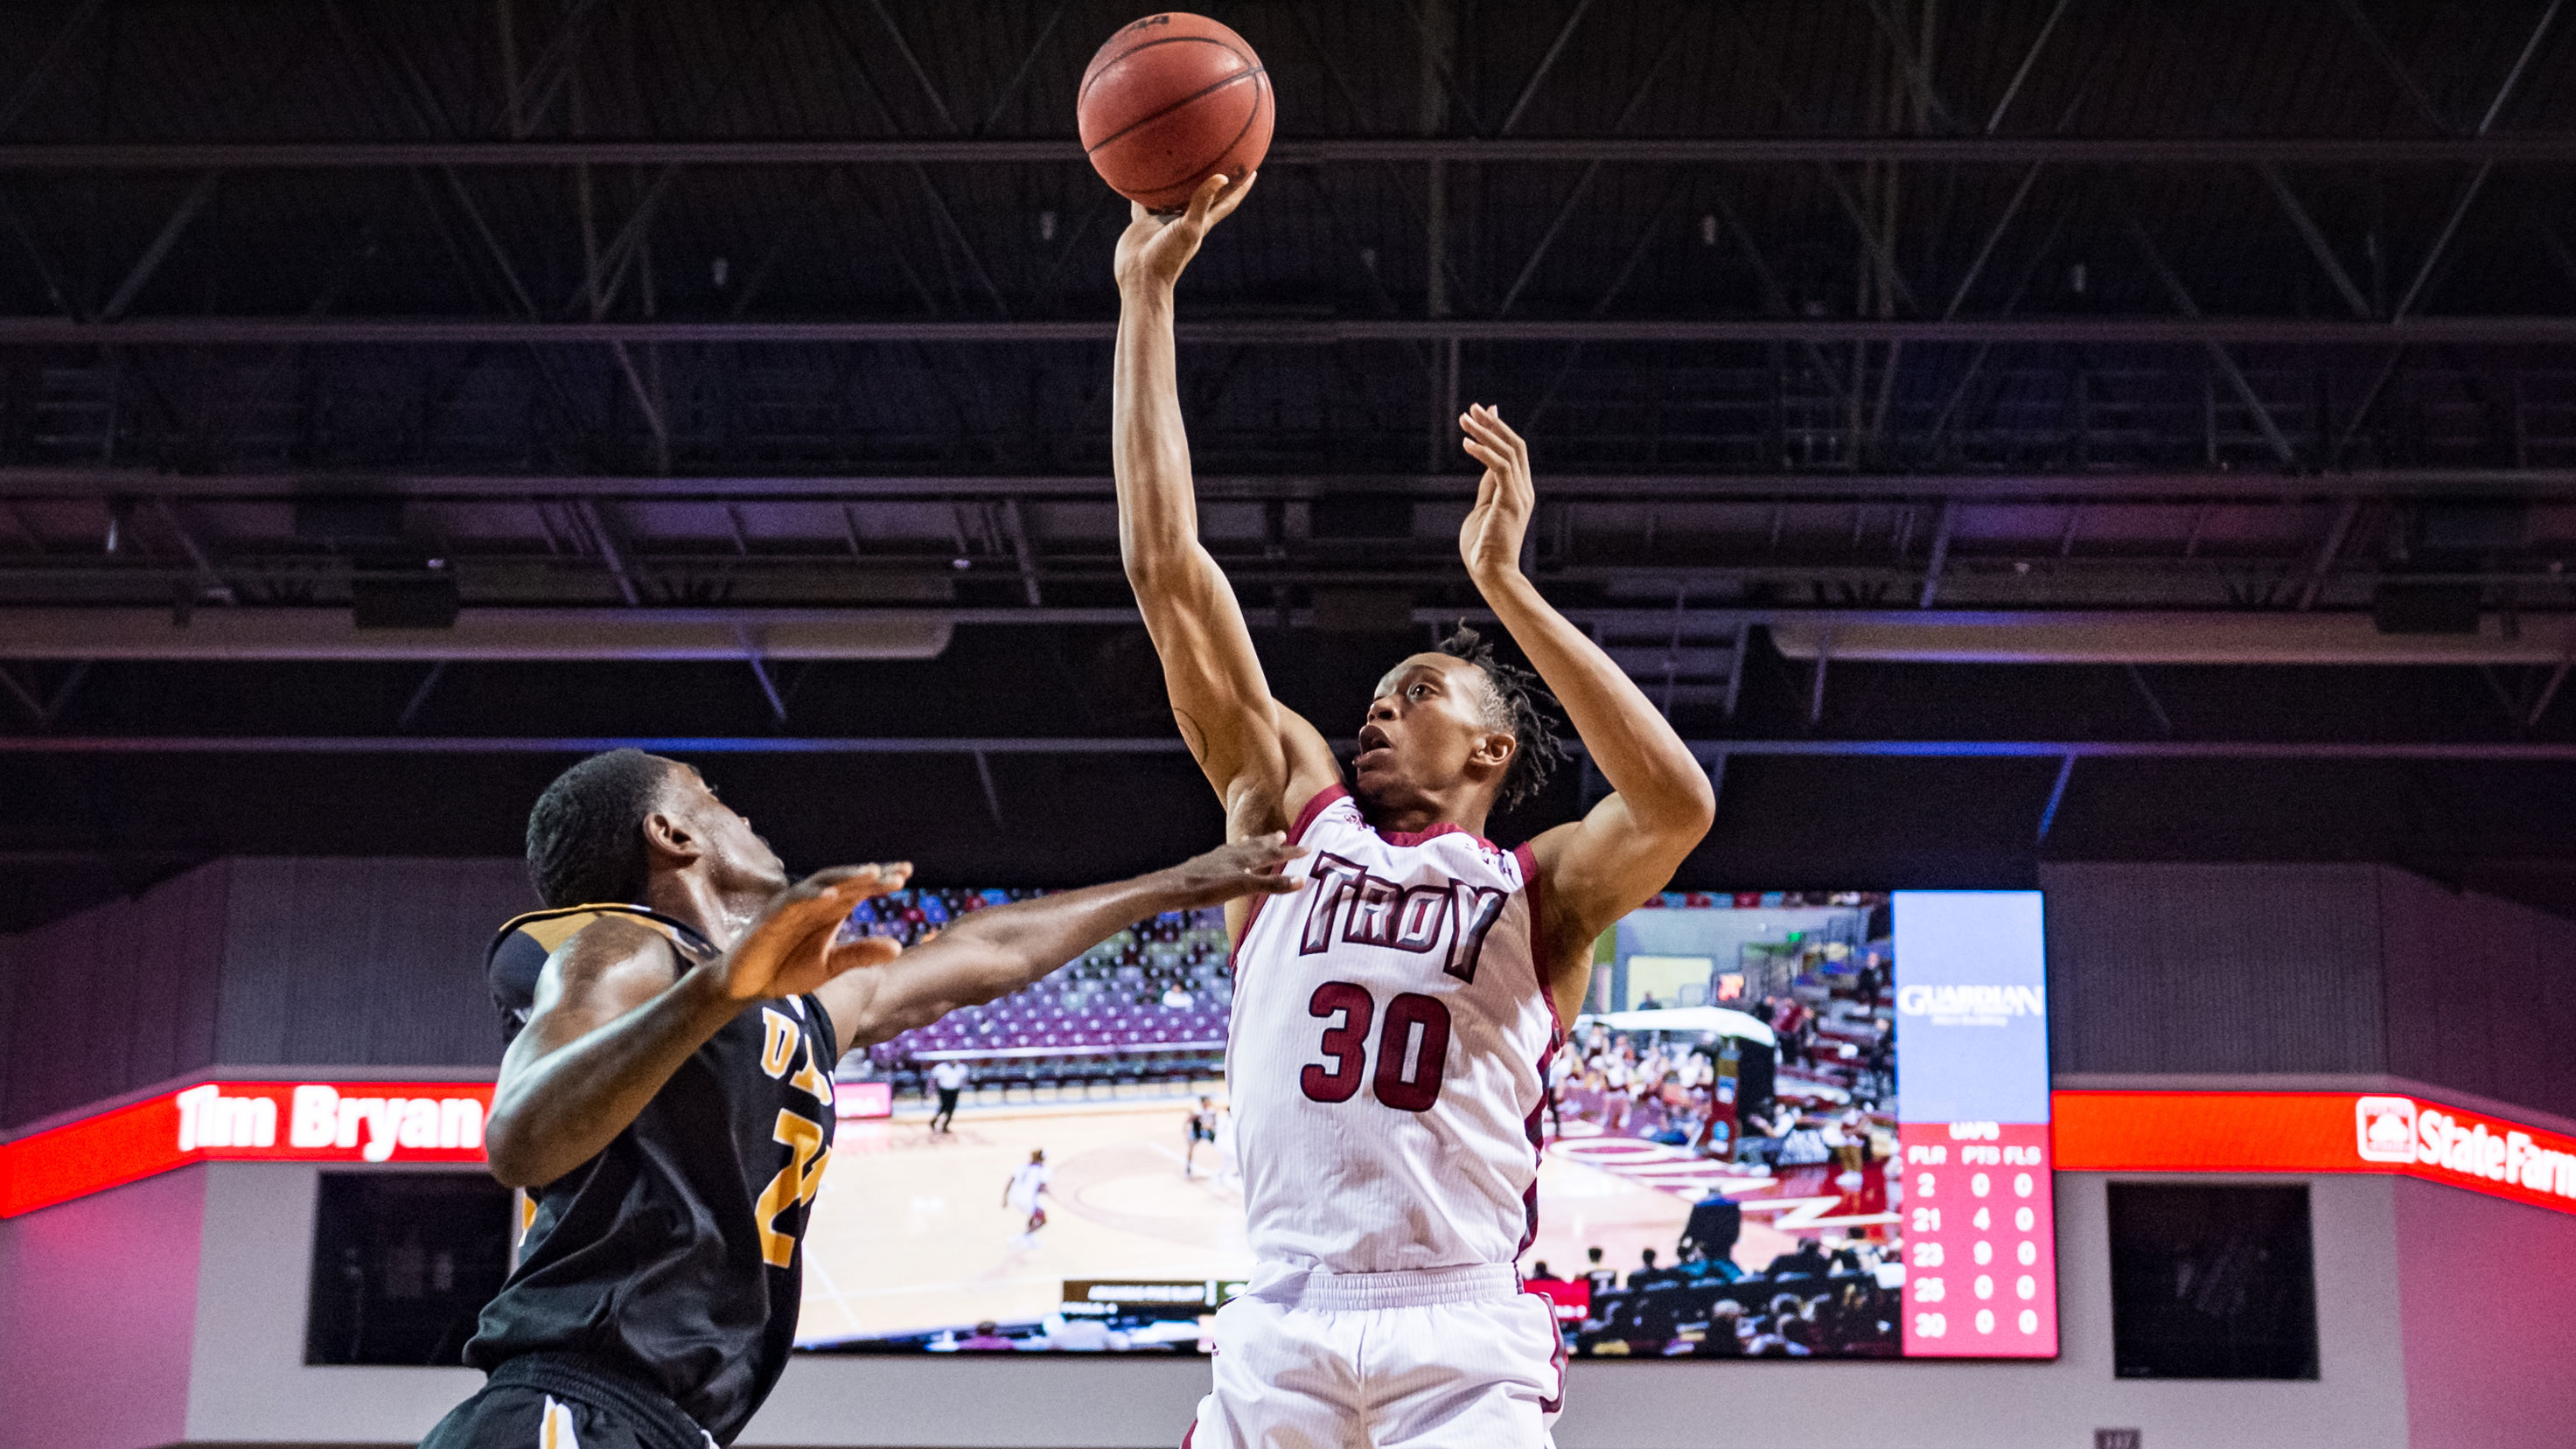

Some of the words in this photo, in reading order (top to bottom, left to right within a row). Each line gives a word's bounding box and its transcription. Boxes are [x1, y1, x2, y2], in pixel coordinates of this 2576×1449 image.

[1299, 850, 1508, 985] TROY
[1897, 985, 2043, 1016] GUARDIAN
[1300, 981, 1451, 1112] 30
[177, 1084, 276, 1152] Tim
[290, 1085, 483, 1161] Bryan
[1908, 1146, 1947, 1165] PLR
[1961, 1146, 2000, 1165] PTS
[2003, 1146, 2041, 1165] FLS
[1917, 1173, 1936, 1197] 2
[1971, 1173, 1990, 1197] 0
[2014, 1173, 2033, 1198] 0
[1912, 1207, 1941, 1232] 21
[1972, 1207, 1991, 1231] 4
[2015, 1207, 2034, 1231] 0
[2017, 1241, 2036, 1265] 0
[1974, 1275, 1993, 1299] 0
[2016, 1275, 2035, 1299] 0
[1975, 1309, 1994, 1334] 0
[2019, 1309, 2038, 1334] 0
